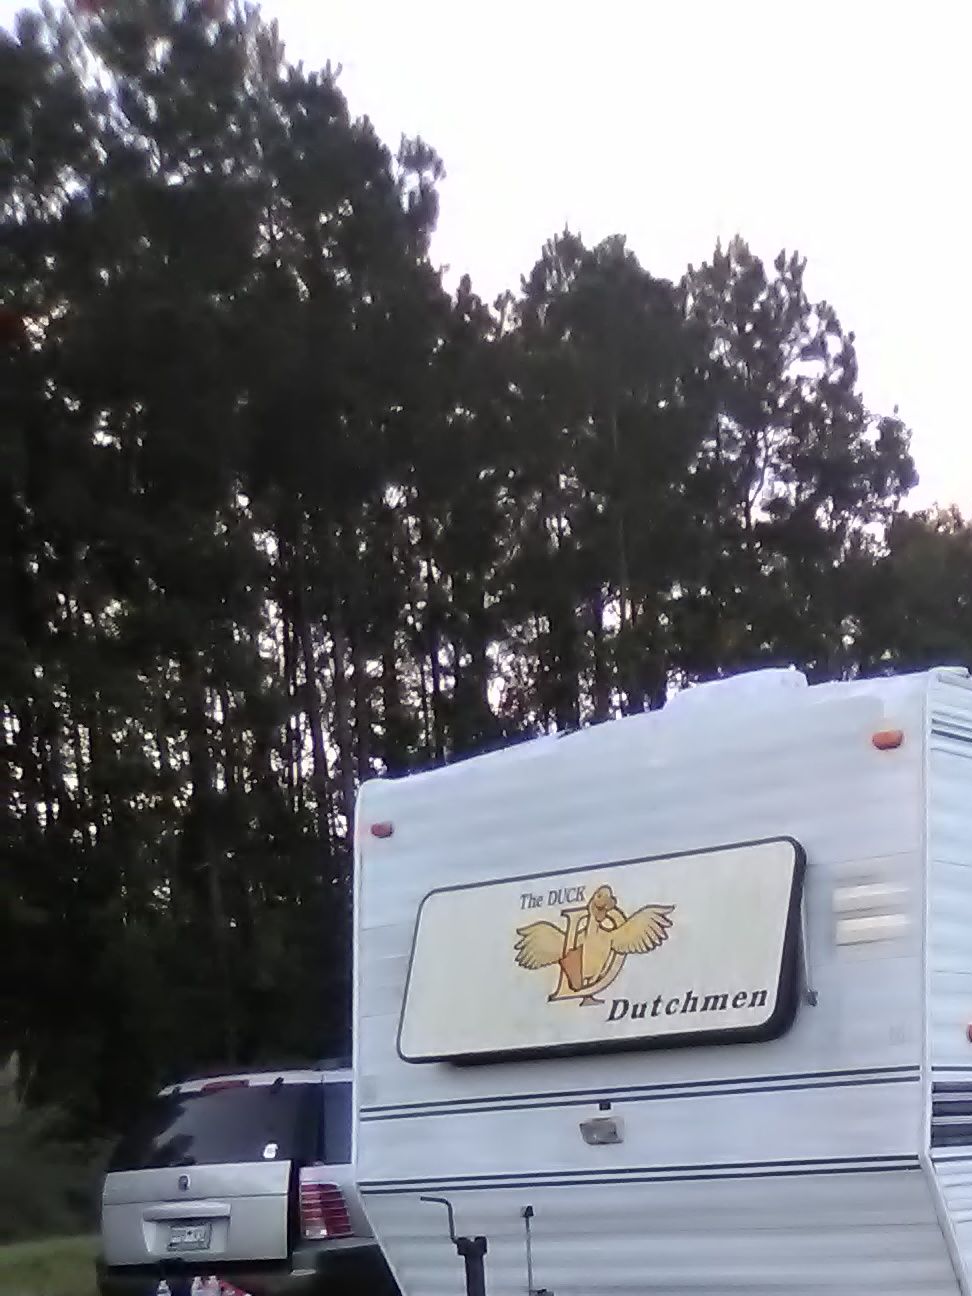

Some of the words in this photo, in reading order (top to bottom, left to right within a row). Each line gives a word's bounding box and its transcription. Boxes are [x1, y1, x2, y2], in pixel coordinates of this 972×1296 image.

[520, 893, 544, 910] The
[548, 885, 587, 906] DUCK
[606, 988, 768, 1022] Dutchmen
